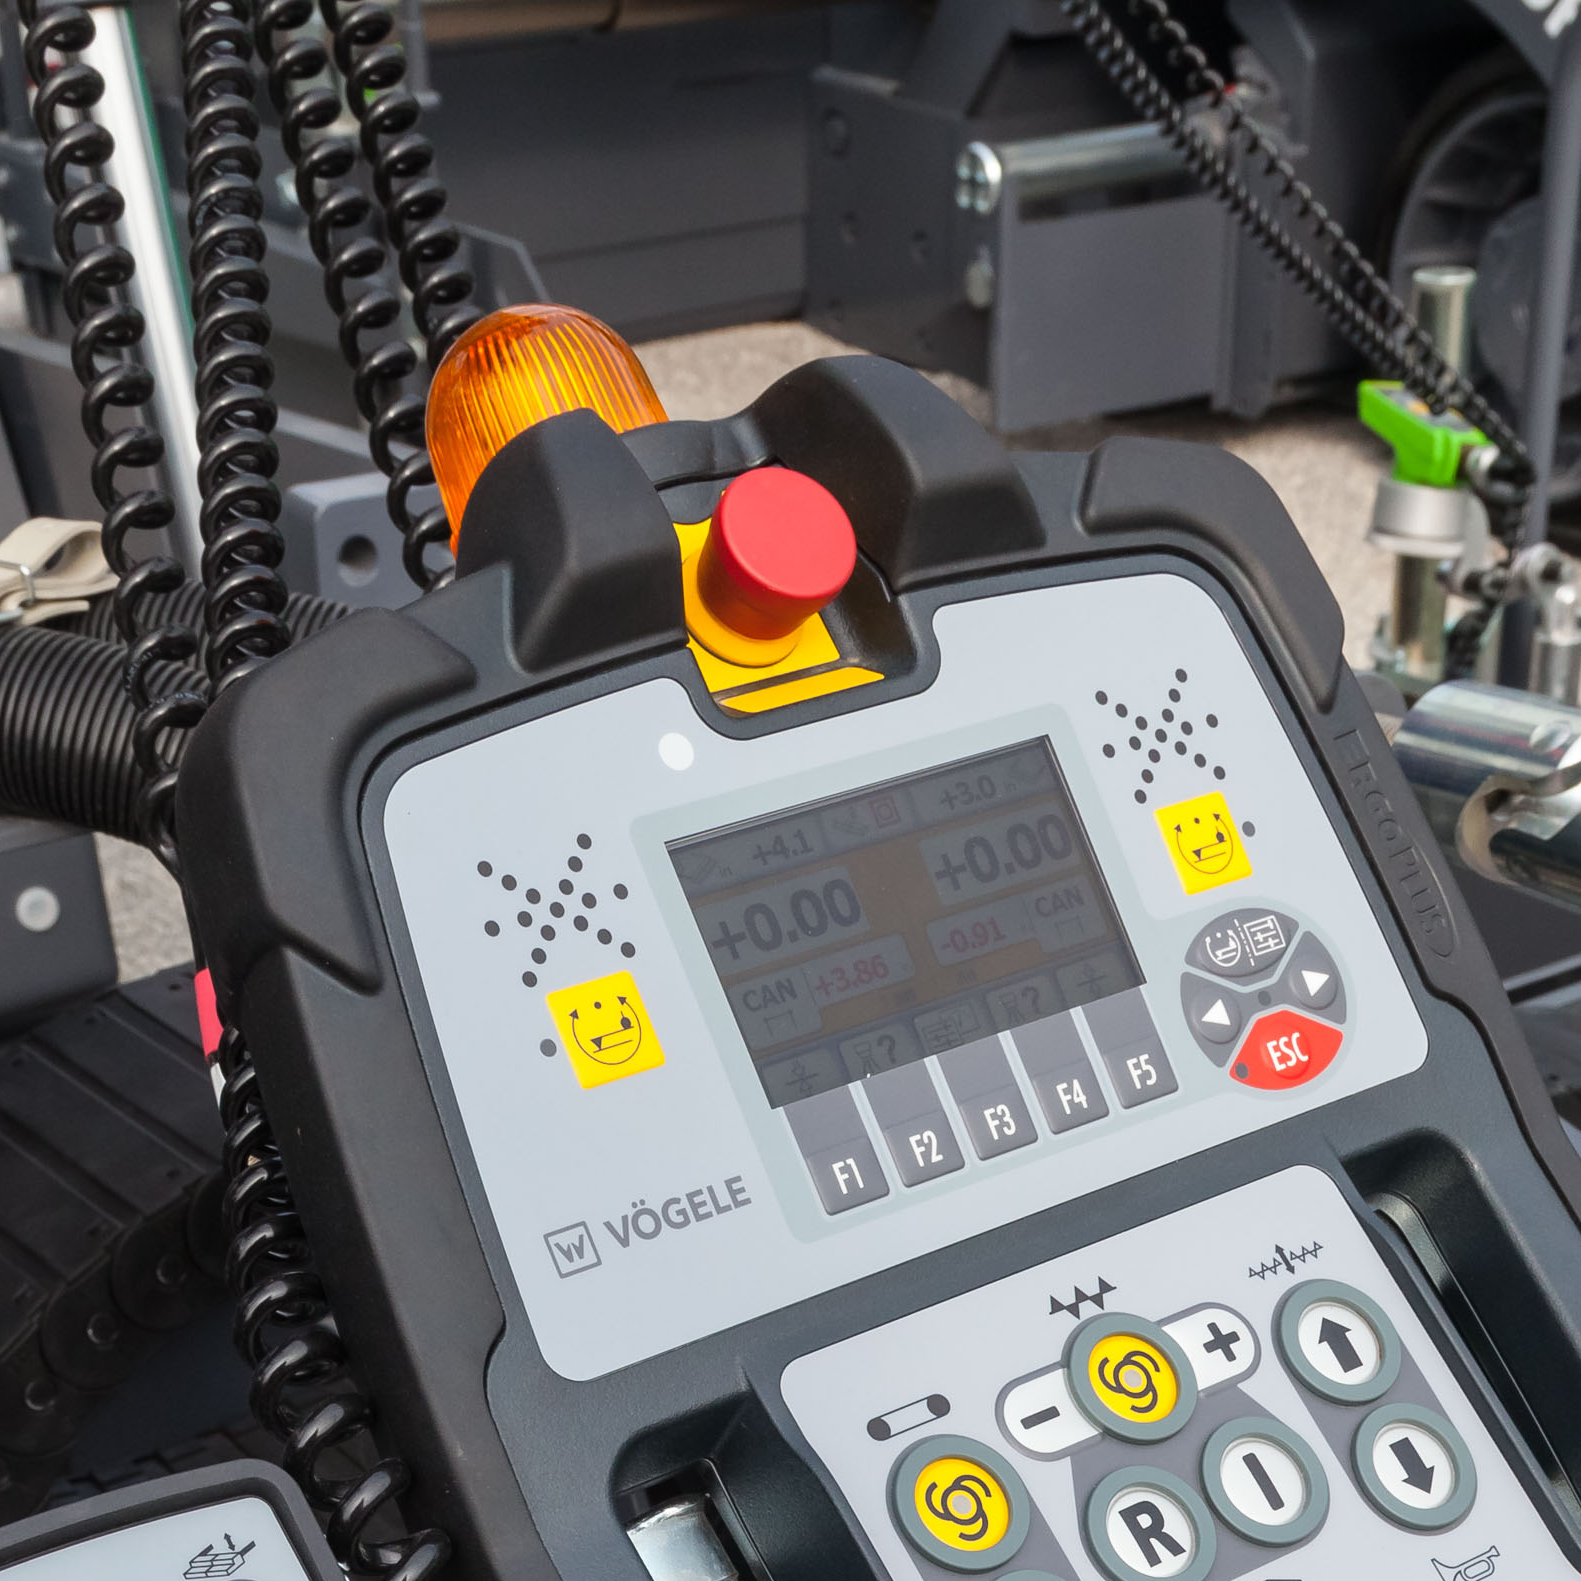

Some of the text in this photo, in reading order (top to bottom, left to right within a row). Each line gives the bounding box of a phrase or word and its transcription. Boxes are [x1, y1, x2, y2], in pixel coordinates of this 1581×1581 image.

[939, 775, 996, 811] +3.0
[752, 831, 814, 868] +4.1
[935, 813, 1073, 892] +0.00
[713, 878, 862, 961] +0.00
[1035, 886, 1085, 918] CAN
[941, 917, 1007, 955] -0.91
[742, 977, 799, 1013] CAN
[816, 955, 890, 999] +3.86
[1266, 1031, 1310, 1072] ESC
[1125, 1053, 1158, 1090] F5
[1056, 1077, 1088, 1115] F4
[983, 1103, 1017, 1142] F3
[909, 1130, 944, 1168] F2
[832, 1157, 867, 1195] F1
[603, 1175, 752, 1249] VÖGELE
[1118, 1500, 1187, 1569] R
